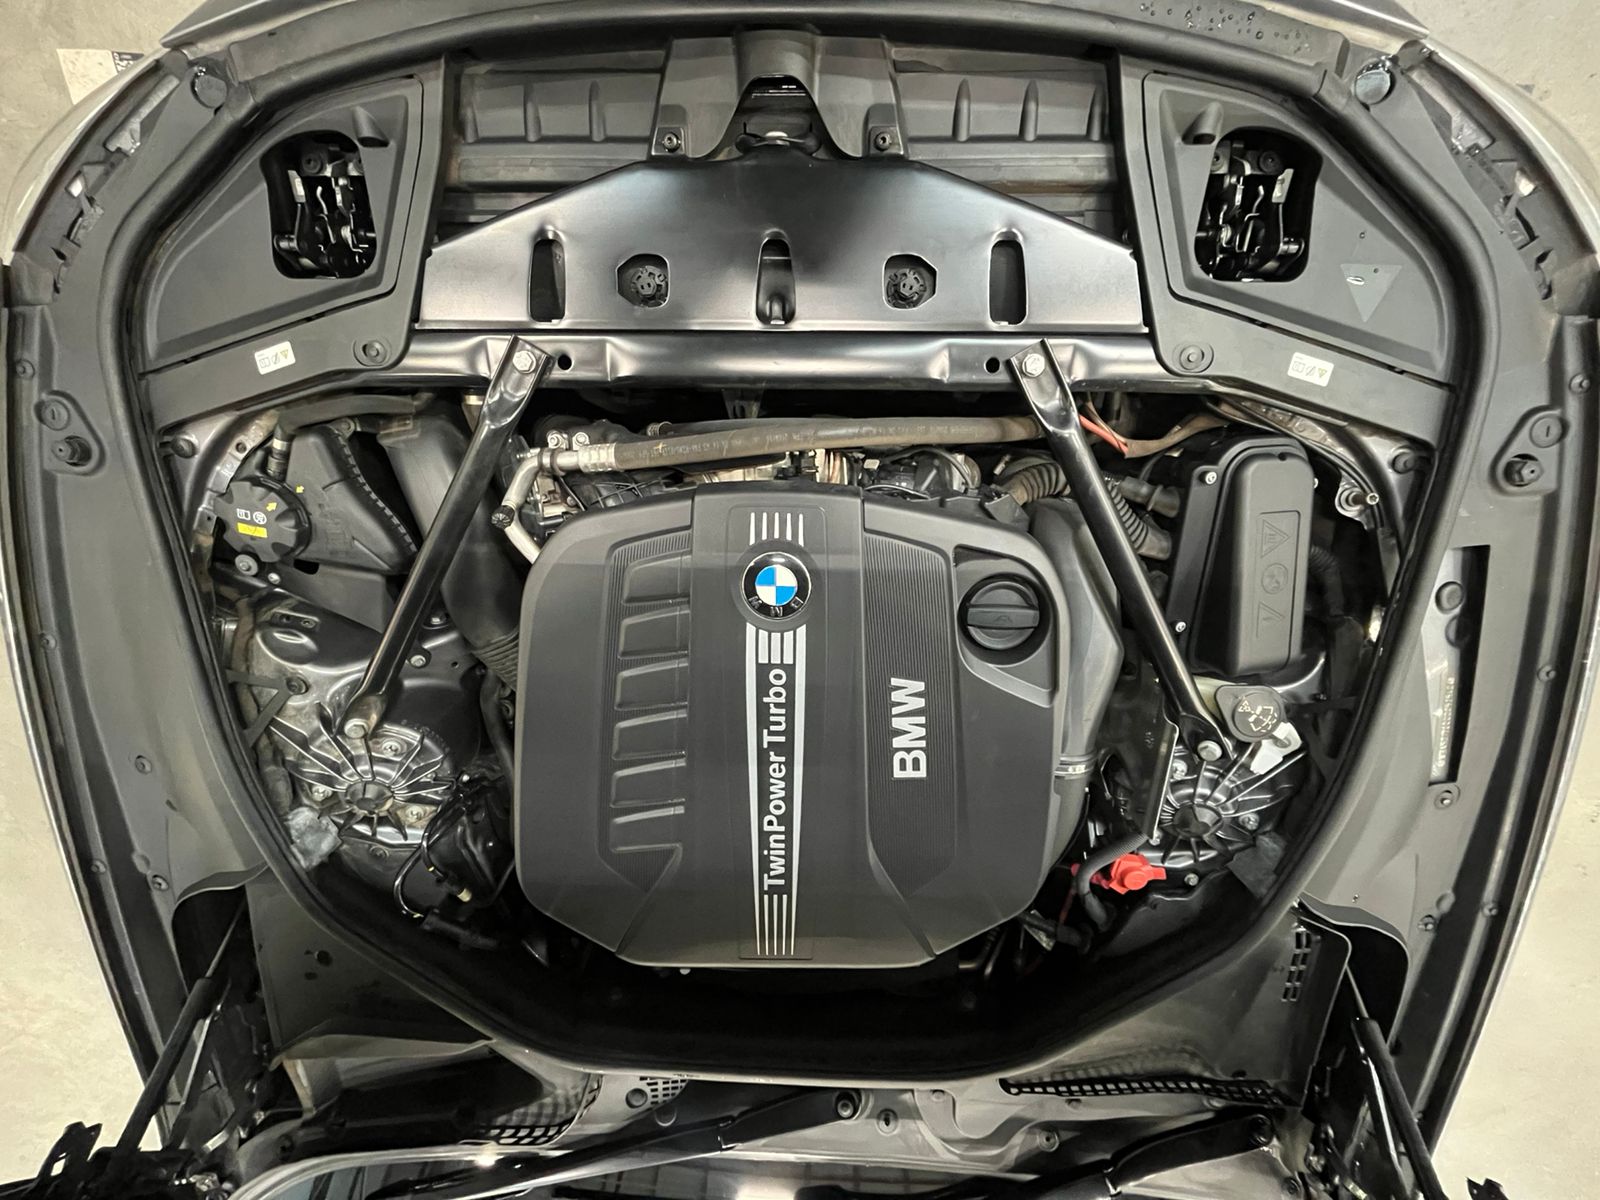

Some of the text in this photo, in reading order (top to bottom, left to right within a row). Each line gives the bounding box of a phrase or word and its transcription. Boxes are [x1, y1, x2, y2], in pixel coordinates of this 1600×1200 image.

[748, 596, 804, 617] BMW
[890, 677, 927, 778] BMW
[763, 668, 787, 891] TwinPower Turbo
